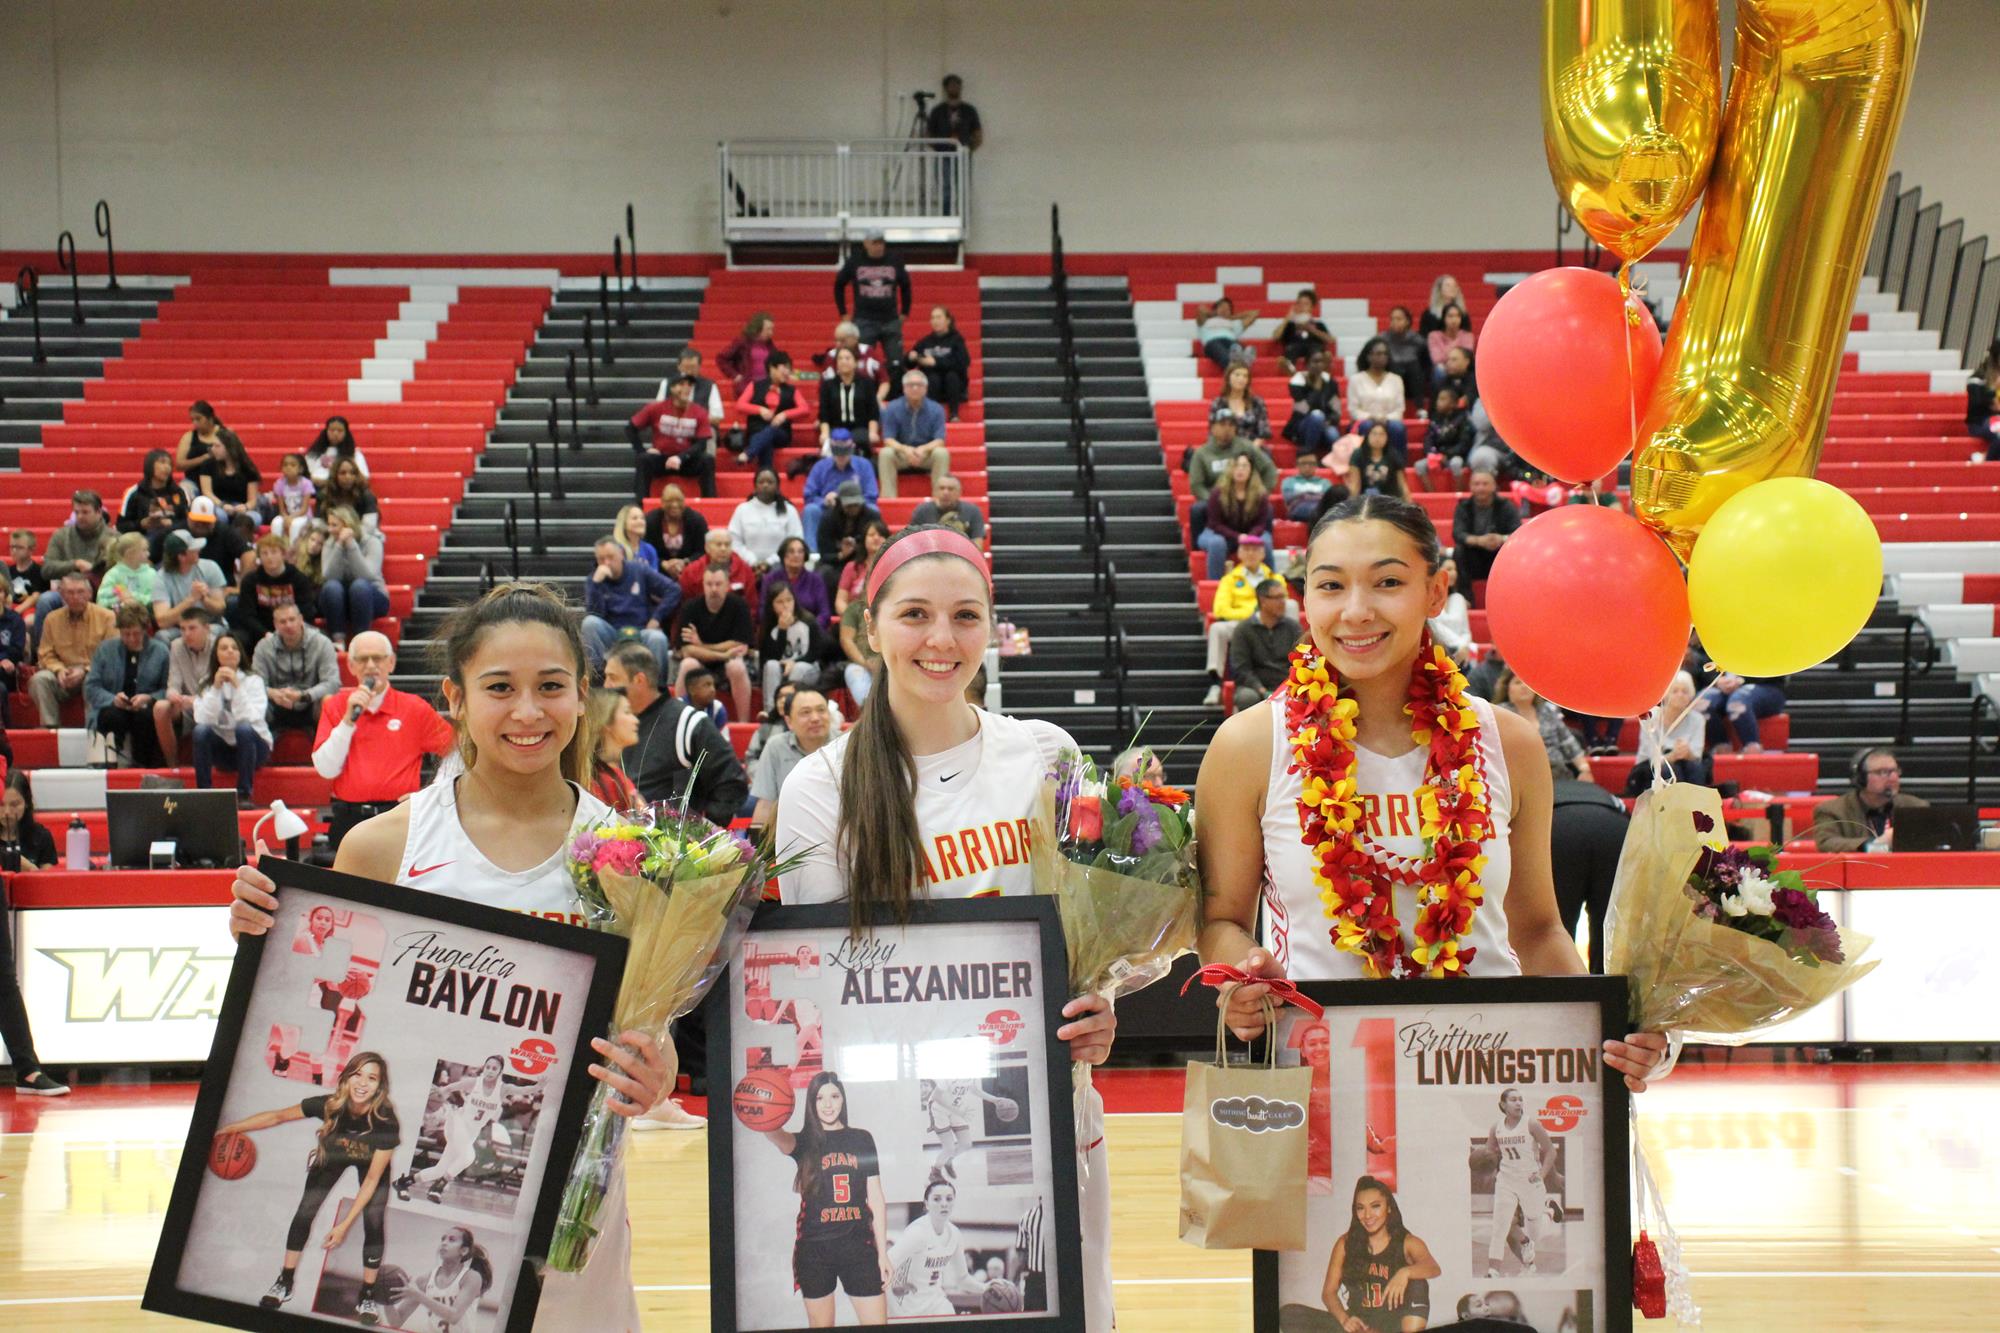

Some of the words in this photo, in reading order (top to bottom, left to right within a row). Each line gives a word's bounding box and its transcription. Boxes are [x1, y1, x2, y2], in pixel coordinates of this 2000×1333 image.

[163, 796, 178, 815] hp
[392, 930, 517, 979] Angelica
[825, 935, 900, 974] Lizzy
[405, 961, 562, 1035] BAYLON
[840, 961, 1033, 1006] ALEXANDER
[1398, 1013, 1509, 1059] Brittney
[510, 1048, 559, 1065] WARRIORS
[1417, 1048, 1598, 1086] LIVINGSTON
[1538, 1109, 1589, 1117] WARRIORS
[822, 1151, 859, 1170] STAN
[833, 1174, 851, 1204] 5
[820, 1206, 862, 1224] STATE
